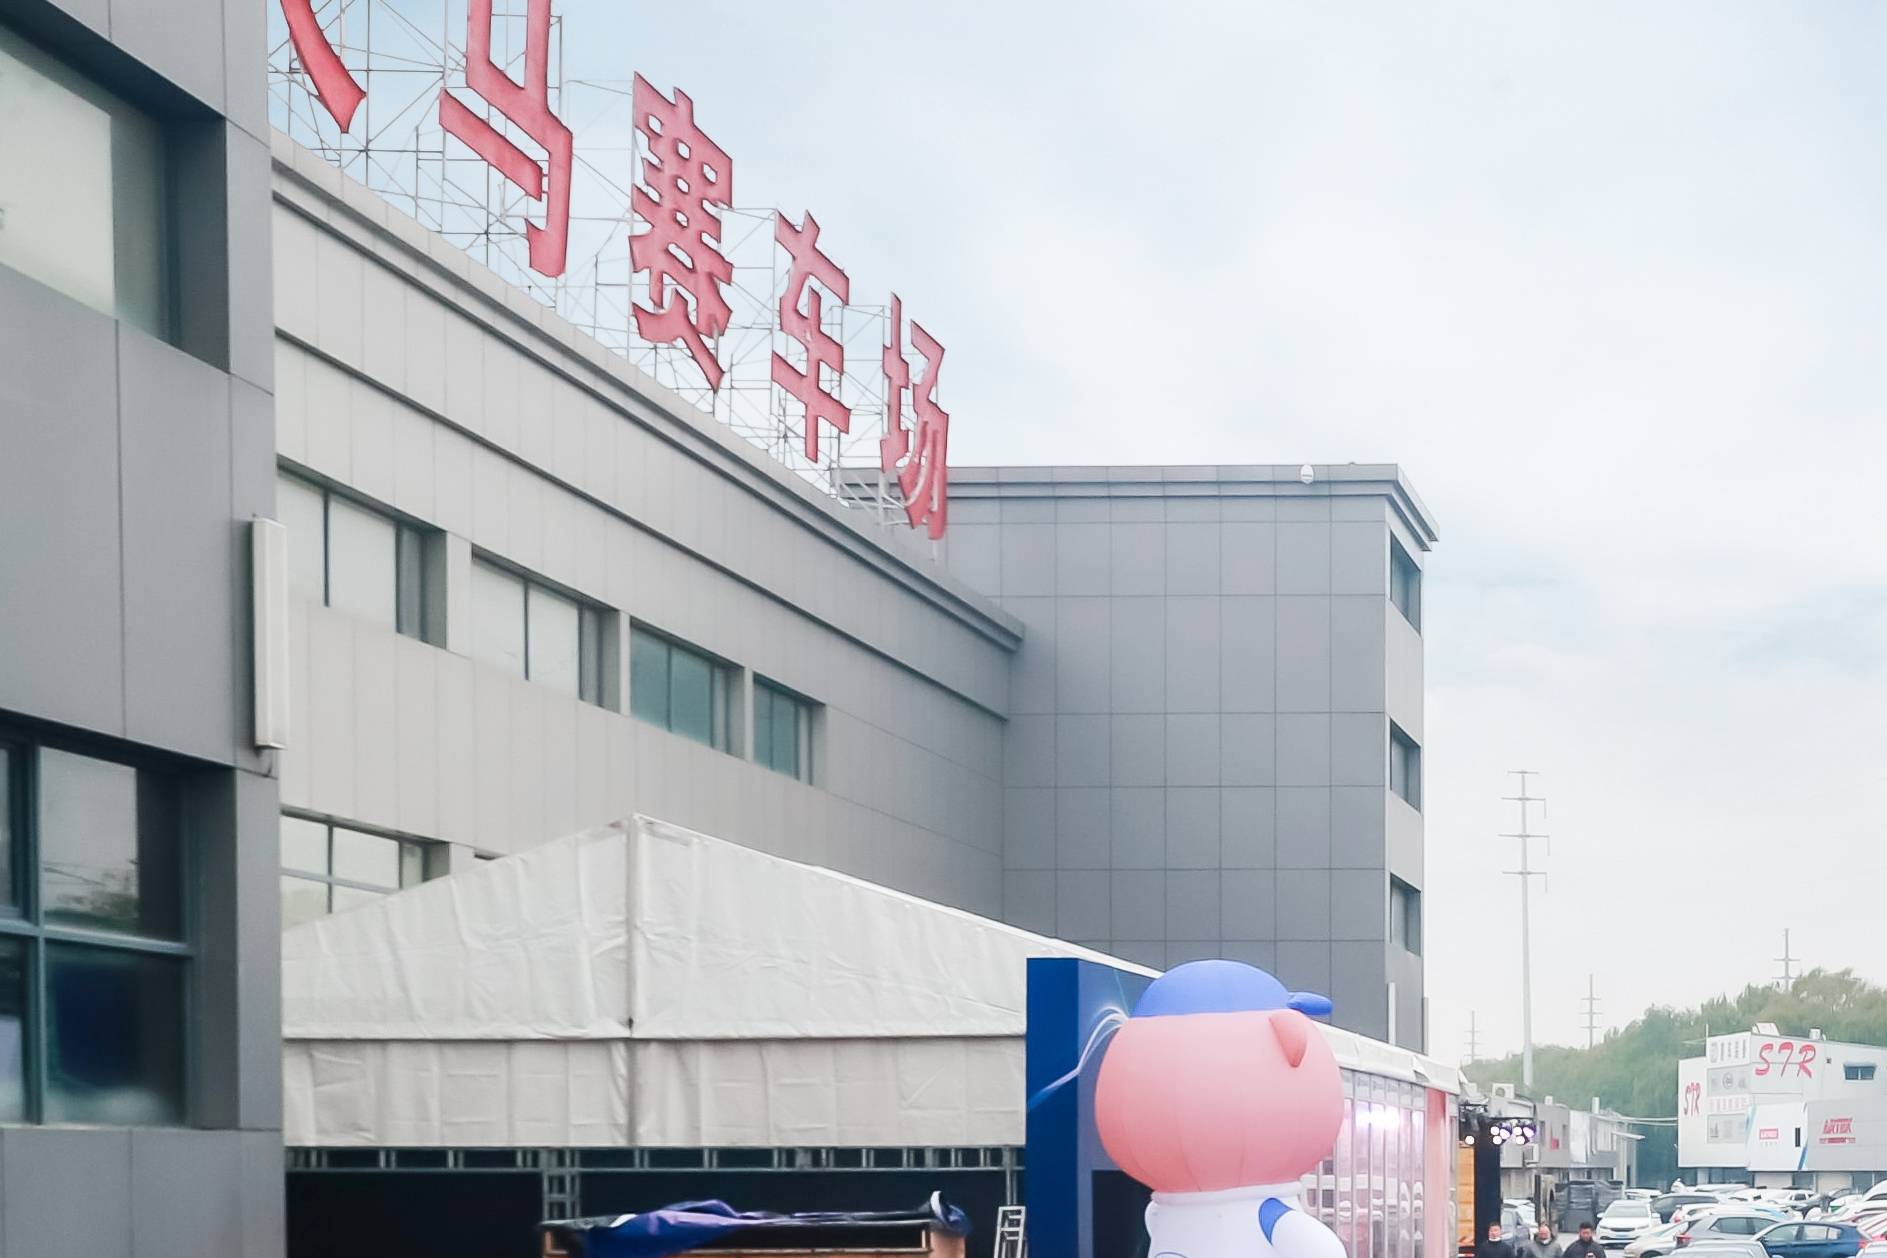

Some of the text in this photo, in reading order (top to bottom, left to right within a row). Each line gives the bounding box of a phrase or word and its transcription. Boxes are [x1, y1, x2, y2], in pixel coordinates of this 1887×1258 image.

[280, 0, 948, 540] 马赛车场
[1755, 1041, 1816, 1079] STR
